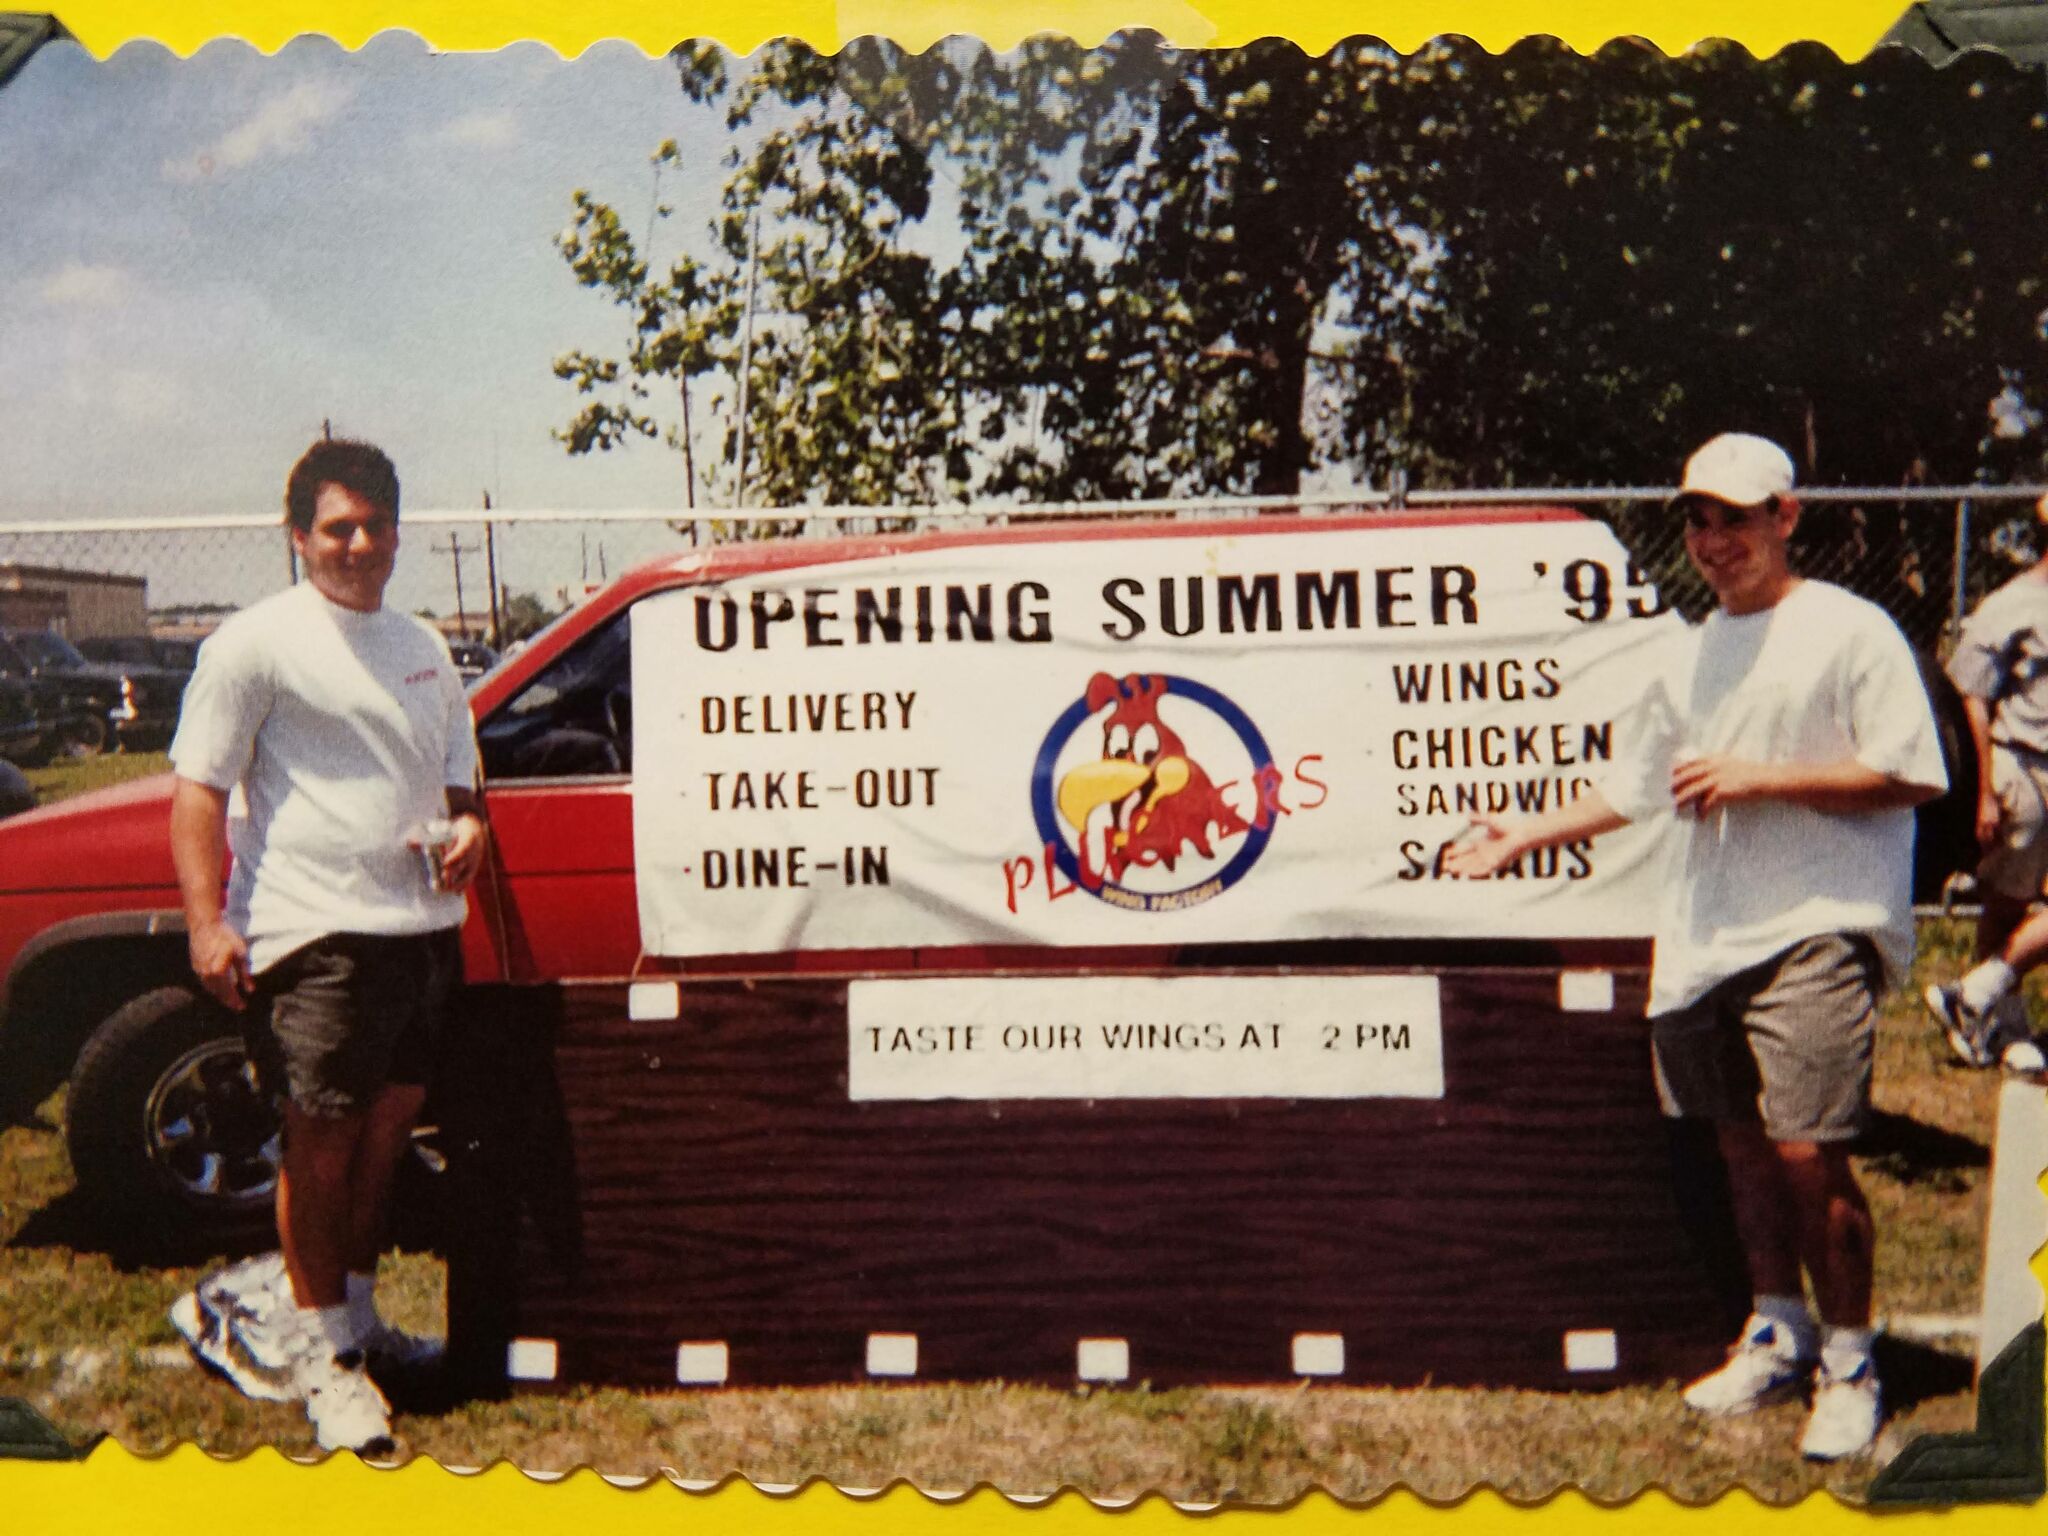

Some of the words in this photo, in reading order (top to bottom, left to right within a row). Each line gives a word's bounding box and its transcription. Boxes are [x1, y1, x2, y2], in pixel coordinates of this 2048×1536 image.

[694, 581, 1054, 652] OPENING
[1101, 565, 1479, 641] SUMMER
[1533, 558, 1671, 625] '95
[1392, 657, 1562, 702] WINGS
[701, 690, 918, 734] DELIVERY
[1392, 719, 1613, 770] CHICKEN
[703, 767, 941, 811] TAKE-OUT
[703, 845, 891, 890] DINE-IN
[865, 1025, 985, 1053] TASTE
[1002, 1024, 1082, 1051] OUR
[1102, 1023, 1226, 1051] WINGS
[1239, 1023, 1283, 1050] AT
[1321, 1024, 1342, 1051] 2
[1356, 1022, 1411, 1050] PM
